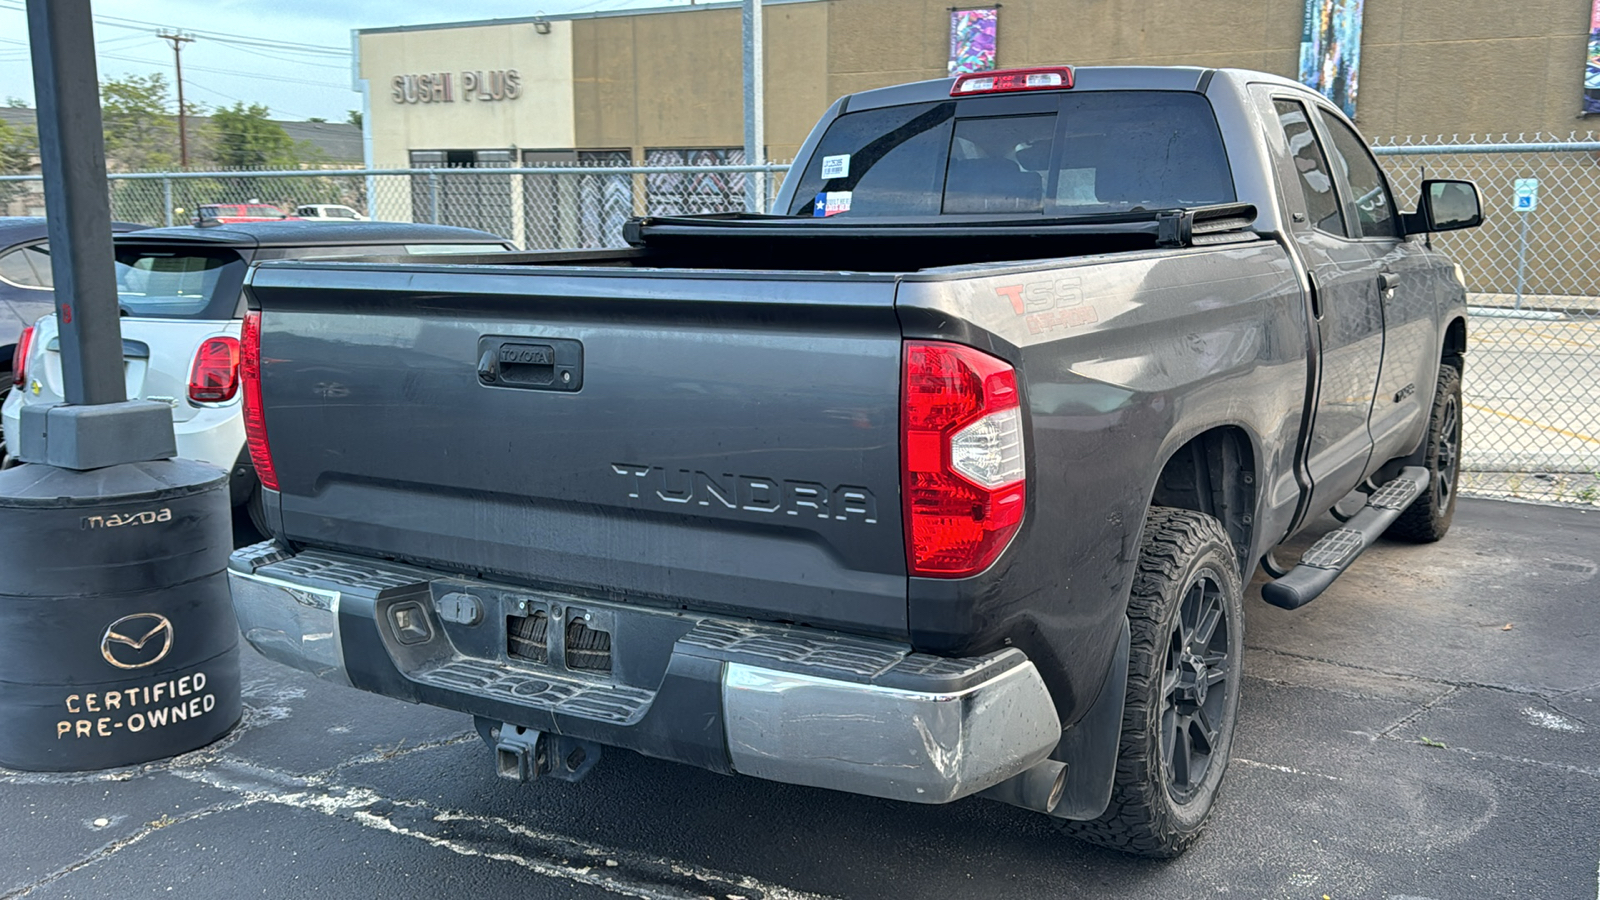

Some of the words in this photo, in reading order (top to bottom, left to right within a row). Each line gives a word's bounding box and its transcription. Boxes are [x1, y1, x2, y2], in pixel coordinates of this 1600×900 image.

[391, 73, 454, 105] SUSHI
[461, 69, 523, 102] PLUS
[995, 276, 1084, 316] TSS
[502, 348, 549, 364] TOYOTA
[611, 462, 878, 524] TUNDRA
[80, 507, 173, 531] mazda
[65, 672, 207, 713] CERTIFIED
[56, 693, 216, 740] PRE-OWNED
